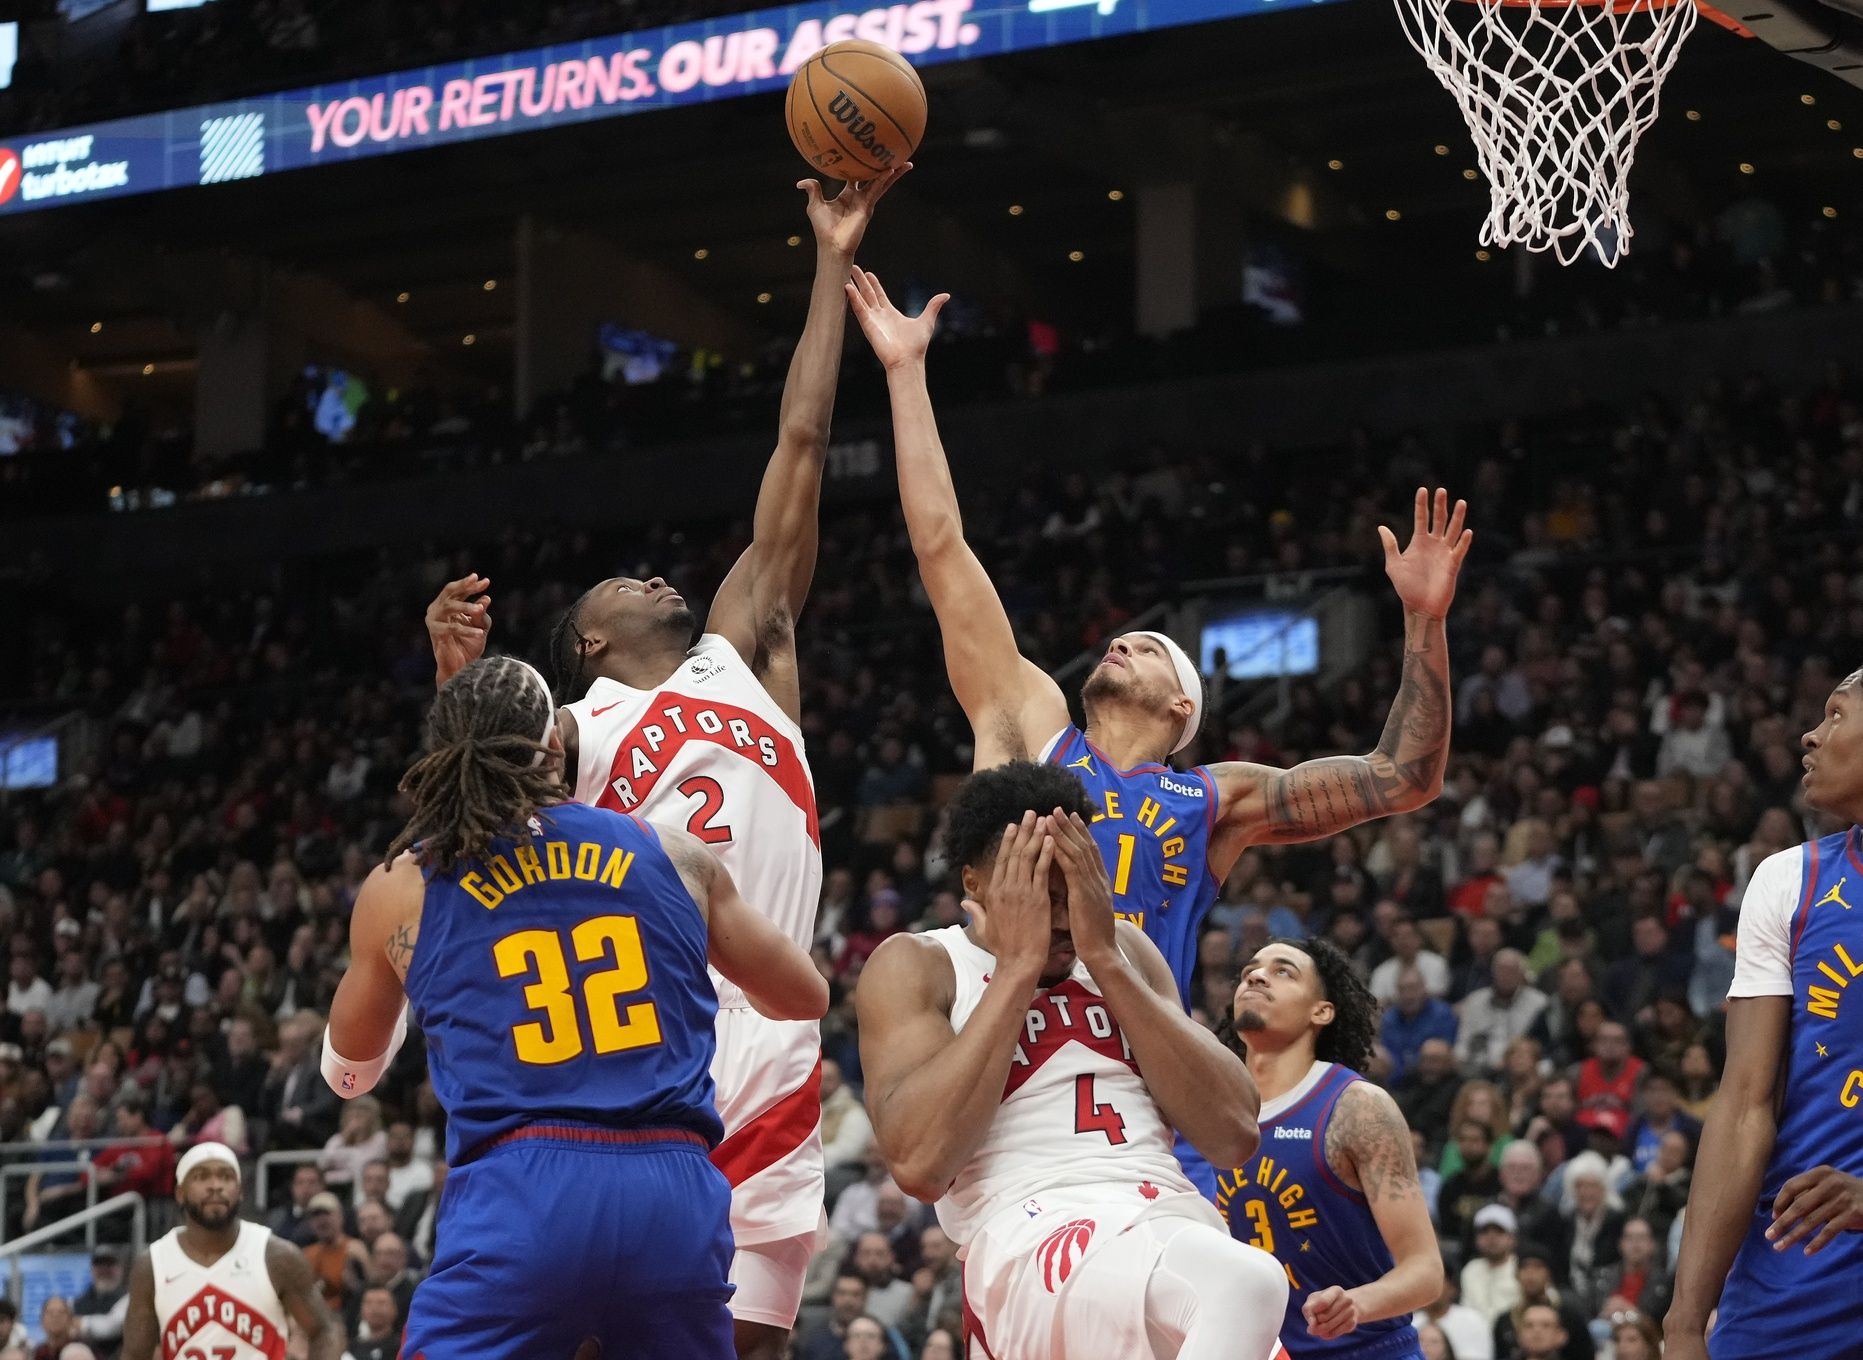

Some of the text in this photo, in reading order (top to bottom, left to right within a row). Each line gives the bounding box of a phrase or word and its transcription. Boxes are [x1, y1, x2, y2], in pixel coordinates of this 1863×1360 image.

[306, 86, 433, 152] YOUR
[438, 48, 655, 131] RETURNS.
[657, 28, 780, 92] OUR
[828, 90, 895, 166] Wilson
[709, 664, 727, 676] Life
[611, 705, 779, 809] RAPTORS
[1160, 776, 1203, 798] ibotta
[676, 775, 733, 845] 2
[1136, 796, 1189, 887] HIGH
[458, 841, 636, 911] GORDON
[1114, 833, 1136, 896] 1
[493, 913, 663, 1067] 32
[1807, 943, 1863, 1019] MIL
[1012, 995, 1131, 1066] APTO
[1075, 1073, 1127, 1146] 4
[1273, 1126, 1312, 1140] ibotta
[1244, 1199, 1275, 1253] 3
[1256, 1156, 1318, 1229] HIGH
